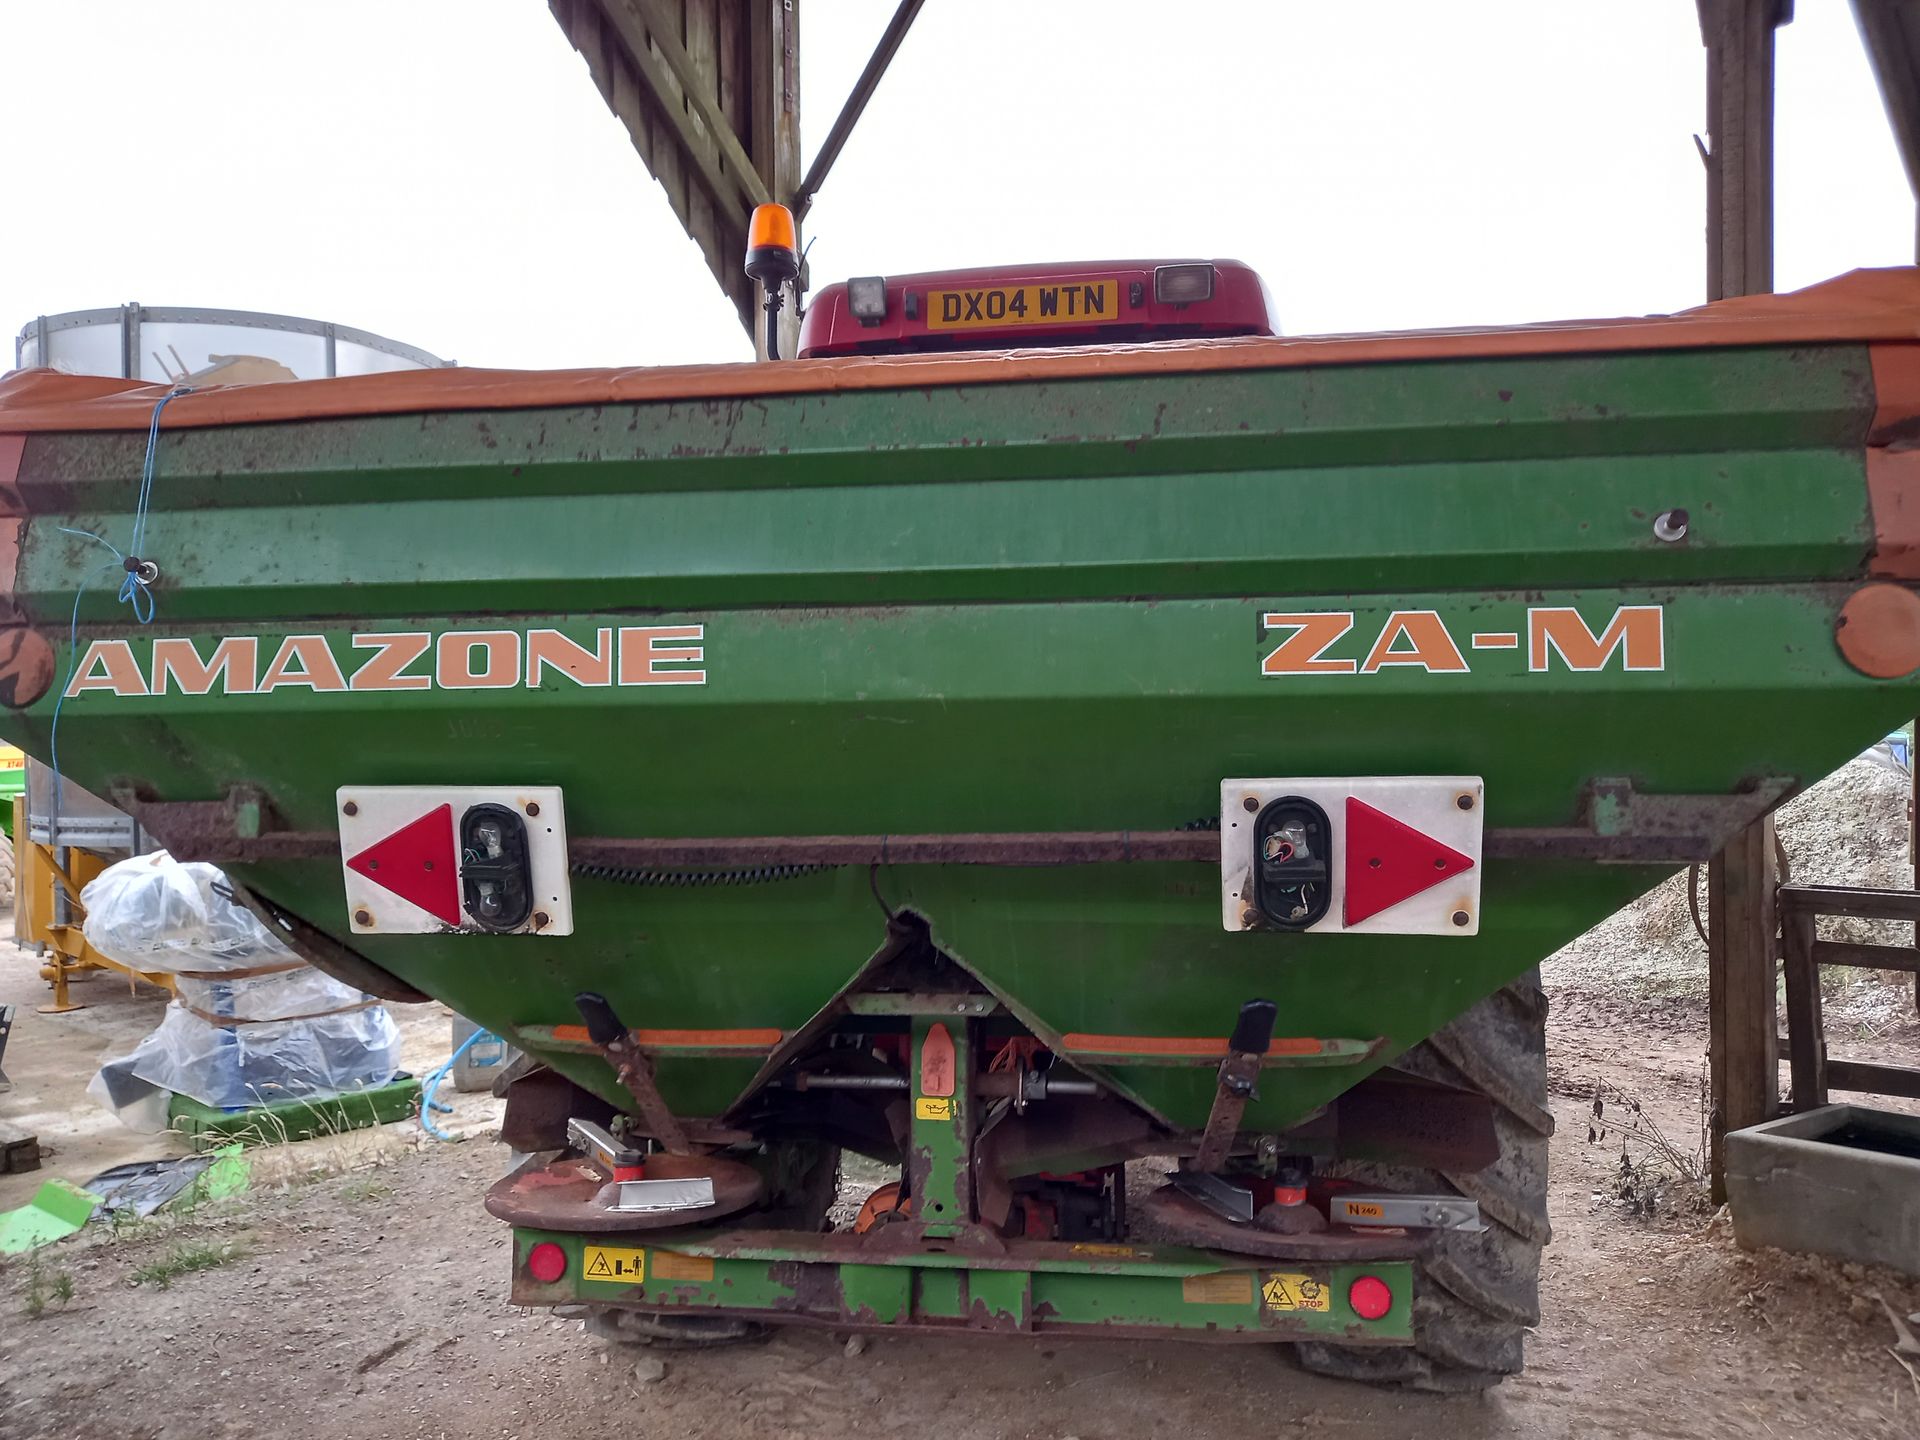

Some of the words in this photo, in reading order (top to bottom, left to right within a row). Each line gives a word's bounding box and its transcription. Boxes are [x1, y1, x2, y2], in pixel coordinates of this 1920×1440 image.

[941, 289, 1029, 323] DX04
[1039, 285, 1105, 317] WTN
[63, 624, 707, 697] AMAZONE
[1261, 605, 1665, 675] ZA-M
[1299, 1300, 1324, 1308] STOP
